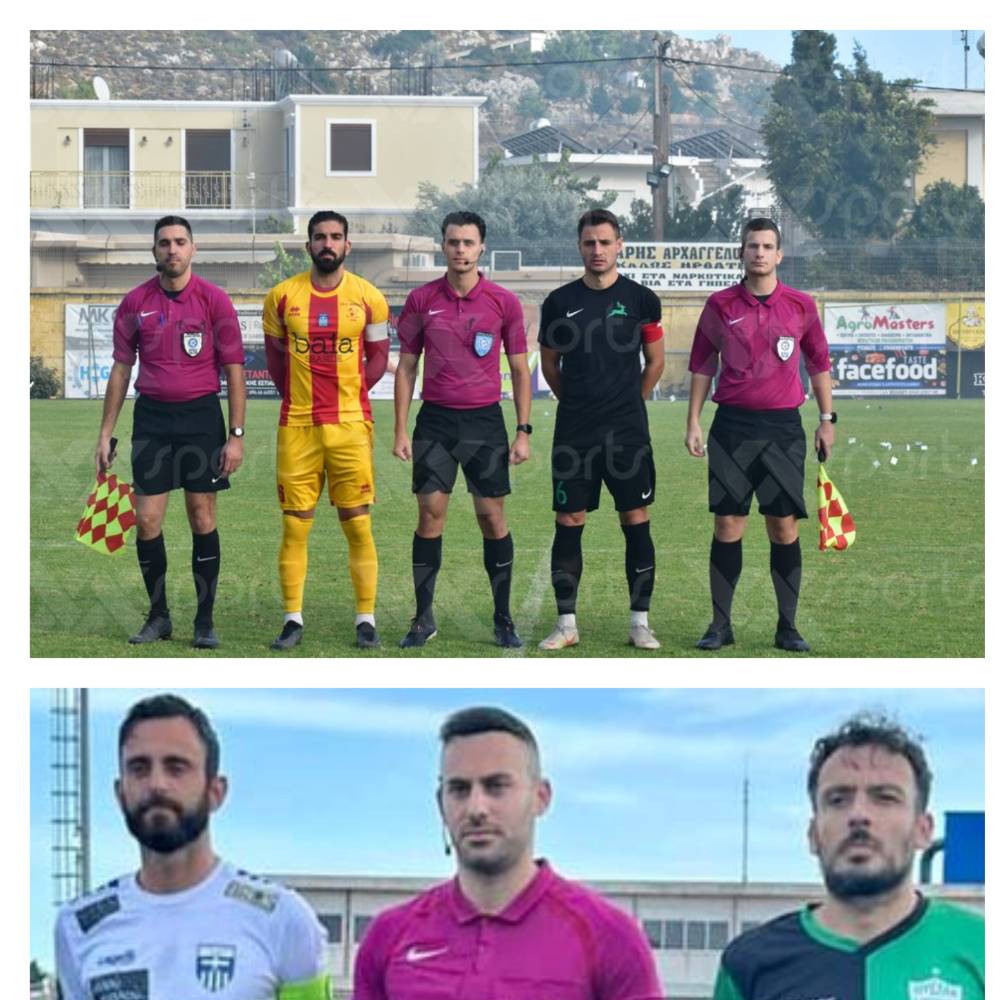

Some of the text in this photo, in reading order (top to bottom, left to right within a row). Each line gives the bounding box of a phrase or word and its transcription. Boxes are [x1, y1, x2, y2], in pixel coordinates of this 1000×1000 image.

[836, 315, 935, 333] AgroMasters
[836, 357, 938, 381] facefood
[556, 480, 567, 505] 6
